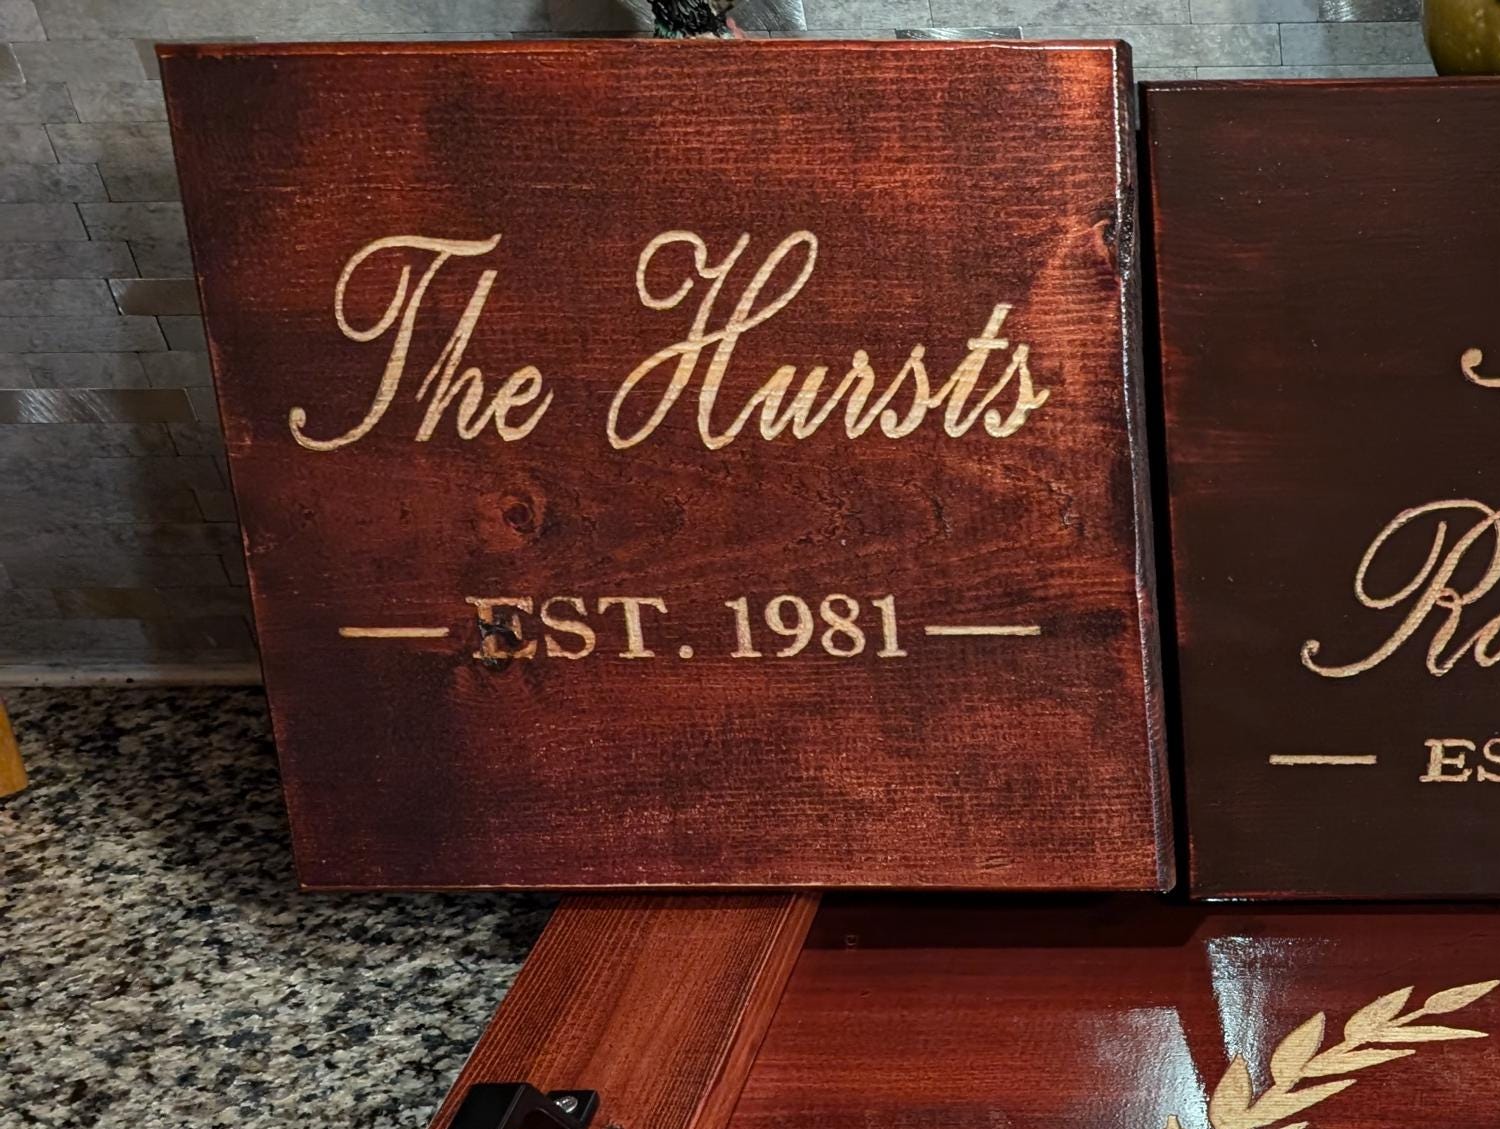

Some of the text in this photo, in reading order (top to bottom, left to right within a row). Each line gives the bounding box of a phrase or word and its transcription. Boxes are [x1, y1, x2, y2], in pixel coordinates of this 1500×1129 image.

[289, 230, 1050, 451] The Hursts
[465, 593, 907, 659] EST. 1981
